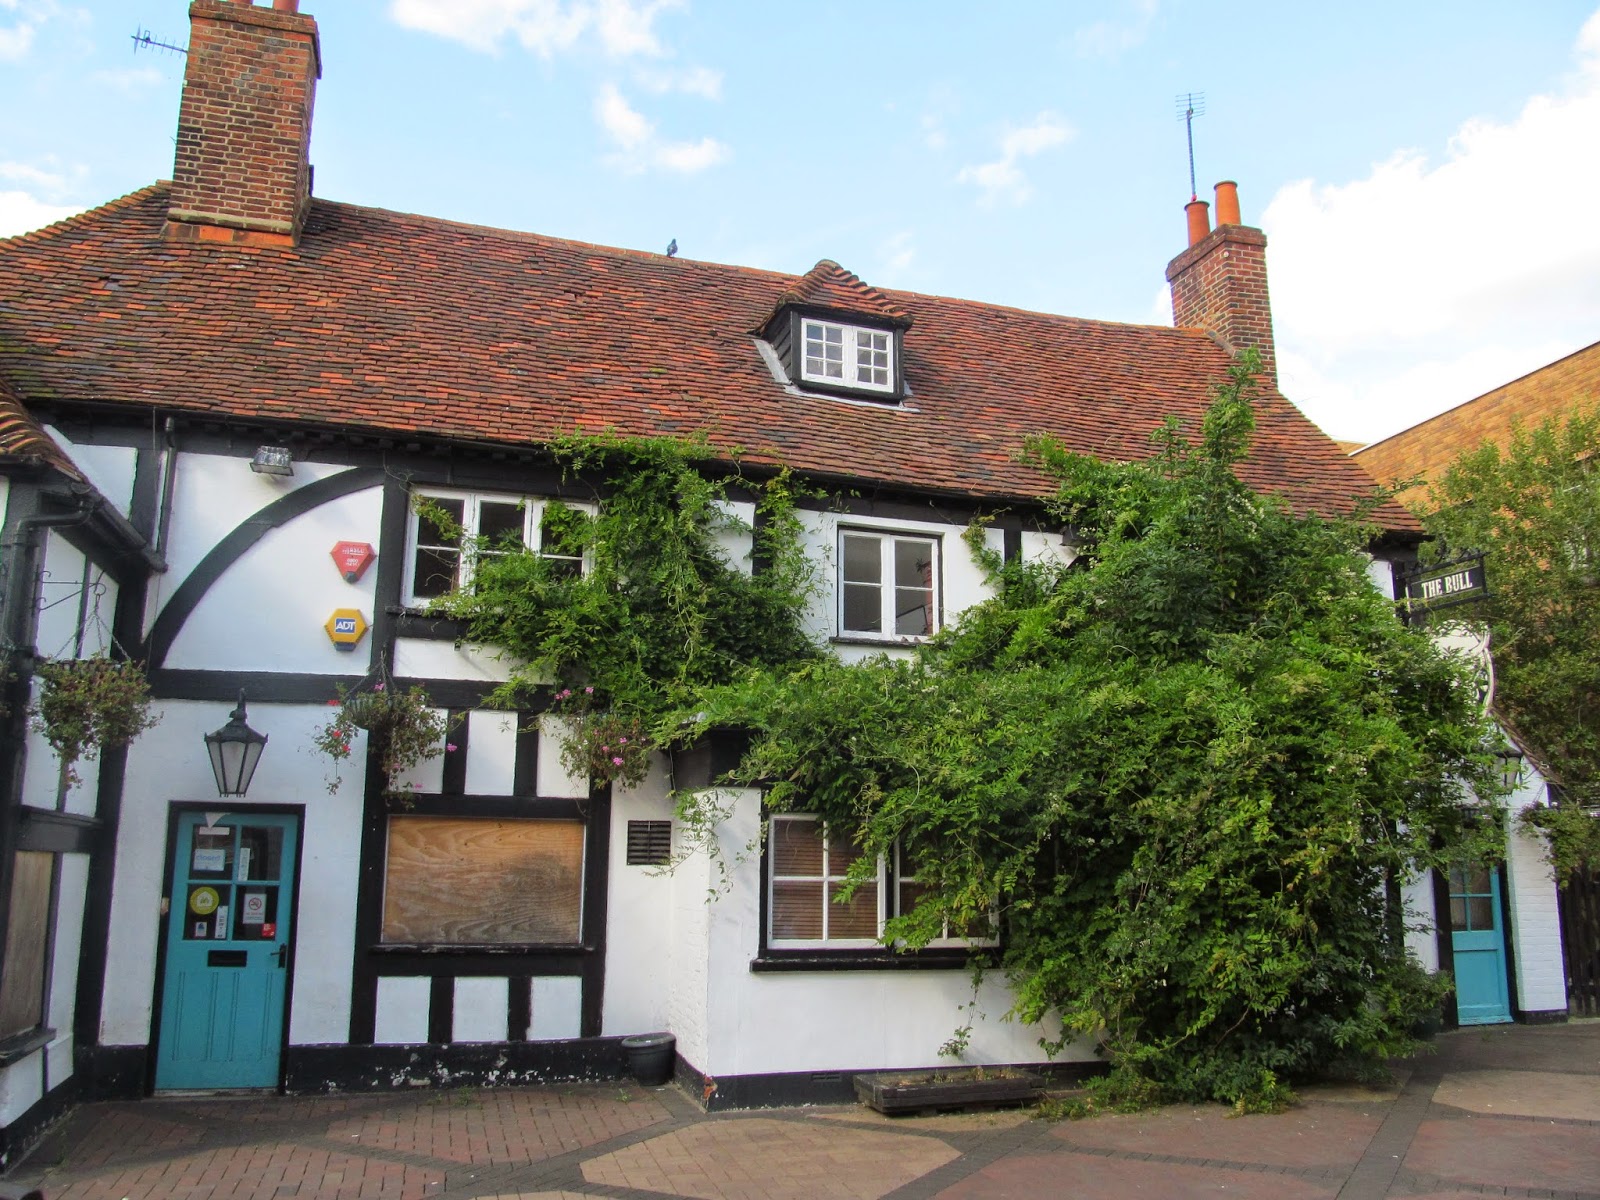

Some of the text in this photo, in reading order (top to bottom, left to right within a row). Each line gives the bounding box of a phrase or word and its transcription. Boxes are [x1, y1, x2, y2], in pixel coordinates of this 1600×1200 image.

[1421, 571, 1473, 599] THE BULL
[336, 621, 356, 631] ADT
